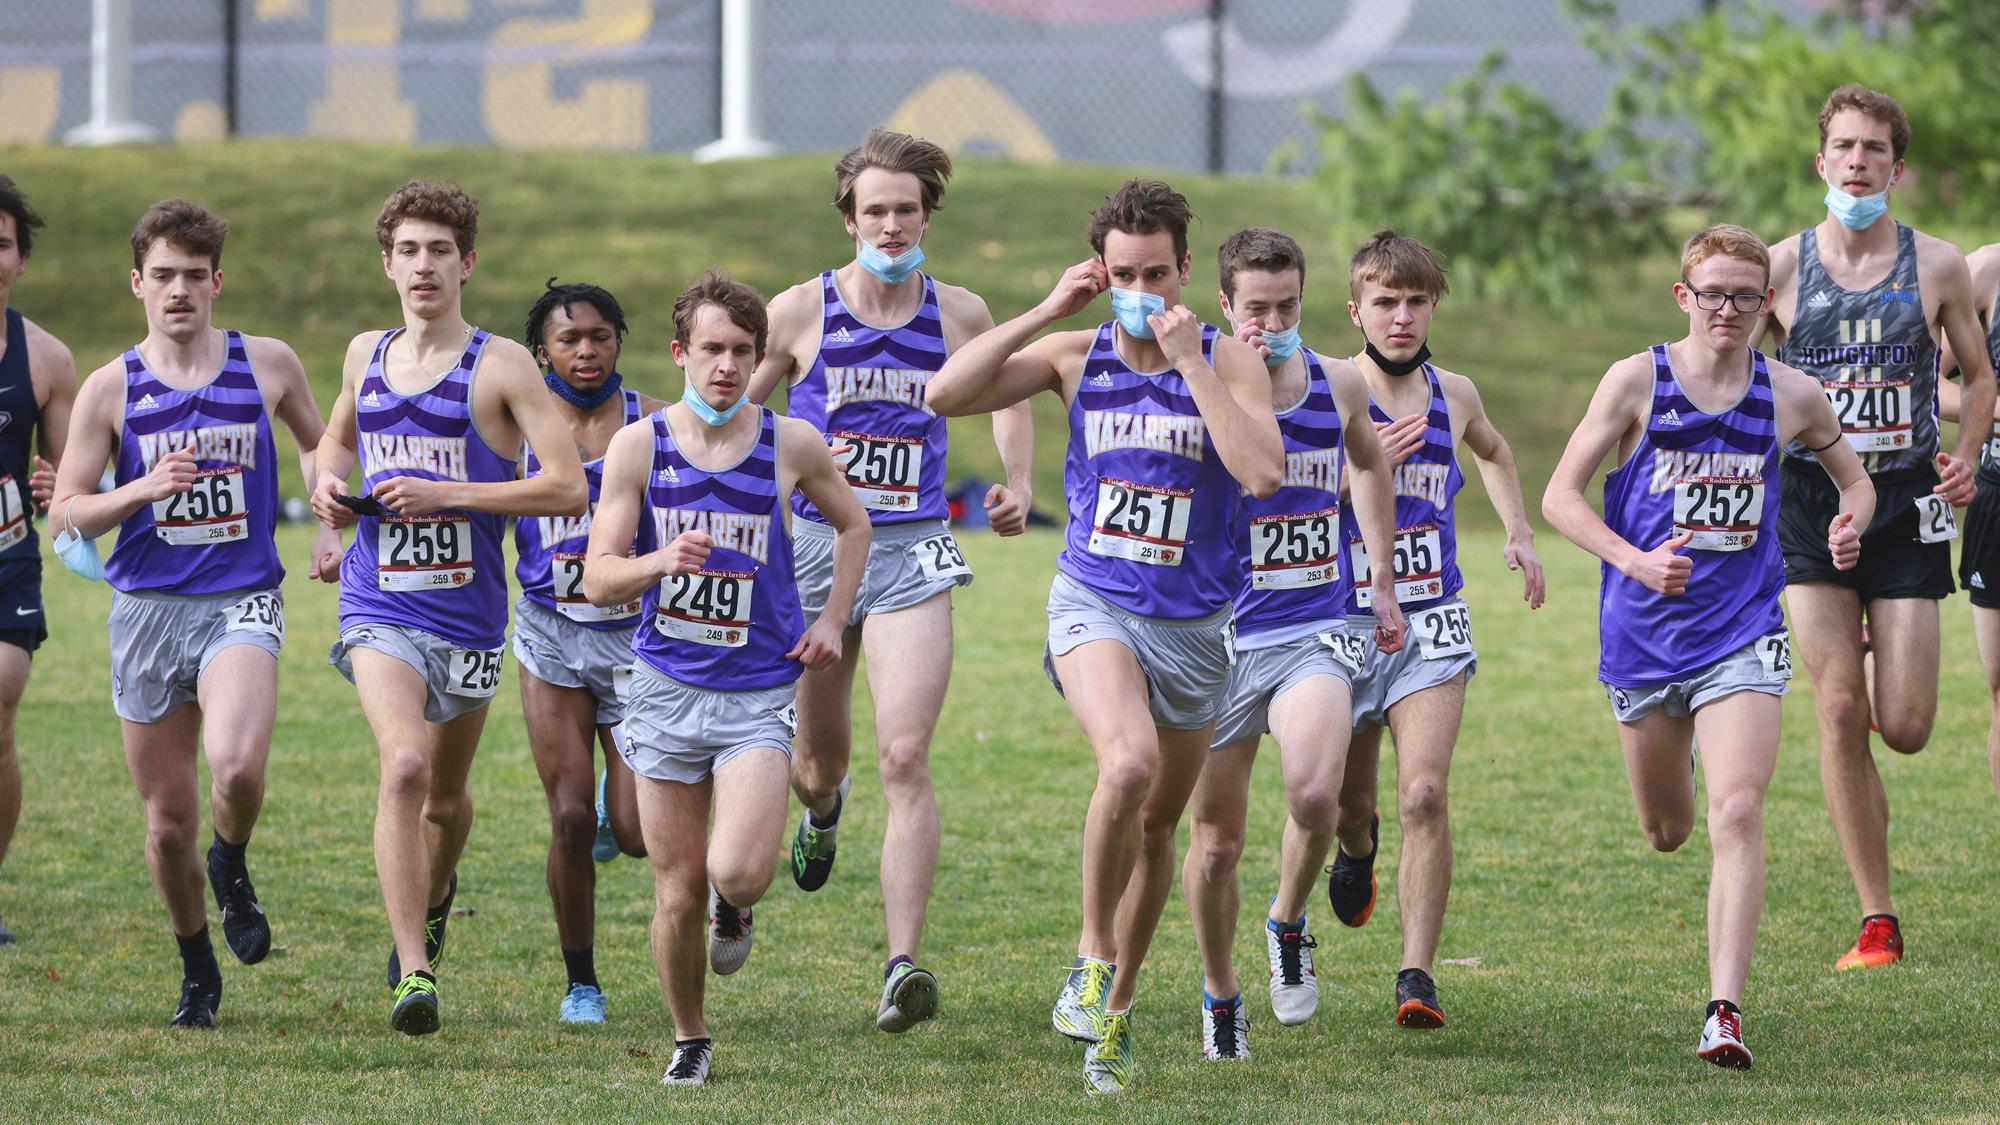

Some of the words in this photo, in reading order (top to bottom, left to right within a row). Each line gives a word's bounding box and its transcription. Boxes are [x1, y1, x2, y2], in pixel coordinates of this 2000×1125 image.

[1801, 344, 1919, 366] HOUGHTON
[134, 403, 160, 411] adidas
[1836, 386, 1900, 429] 240
[1657, 418, 1683, 427] adidas
[841, 431, 861, 440] Fisher
[866, 434, 900, 443] Rodenbeck
[1084, 410, 1203, 464] NAZARETH
[1876, 436, 1891, 446] 240
[360, 431, 469, 482] NAZARETH
[845, 438, 911, 487] 250
[216, 466, 236, 476] Invite
[658, 474, 680, 483] adidas
[1709, 477, 1742, 485] Rodenbeck
[1107, 478, 1126, 487] Fisher
[1130, 481, 1166, 495] Rodenbeck
[1166, 488, 1186, 497] Invite
[1394, 463, 1450, 511] ARETH
[166, 474, 233, 522] 256
[880, 494, 895, 505] 250
[1685, 482, 1754, 528] 252
[1103, 486, 1175, 541] 251
[1283, 511, 1317, 522] Rodenbeck
[1928, 498, 1955, 535] 24
[208, 527, 225, 539] 256
[1415, 523, 1433, 532] Invite
[389, 522, 459, 567] 259
[1262, 516, 1331, 566] 253
[1724, 536, 1739, 546] 252
[925, 536, 965, 571] 25
[1141, 546, 1157, 559] 251
[1363, 530, 1432, 581] 55
[432, 574, 449, 585] 259
[728, 571, 748, 579] Invite
[1307, 570, 1322, 582] 253
[669, 572, 739, 621] 249
[1409, 585, 1425, 597] 255
[608, 604, 625, 616] 254
[706, 629, 723, 641] 249
